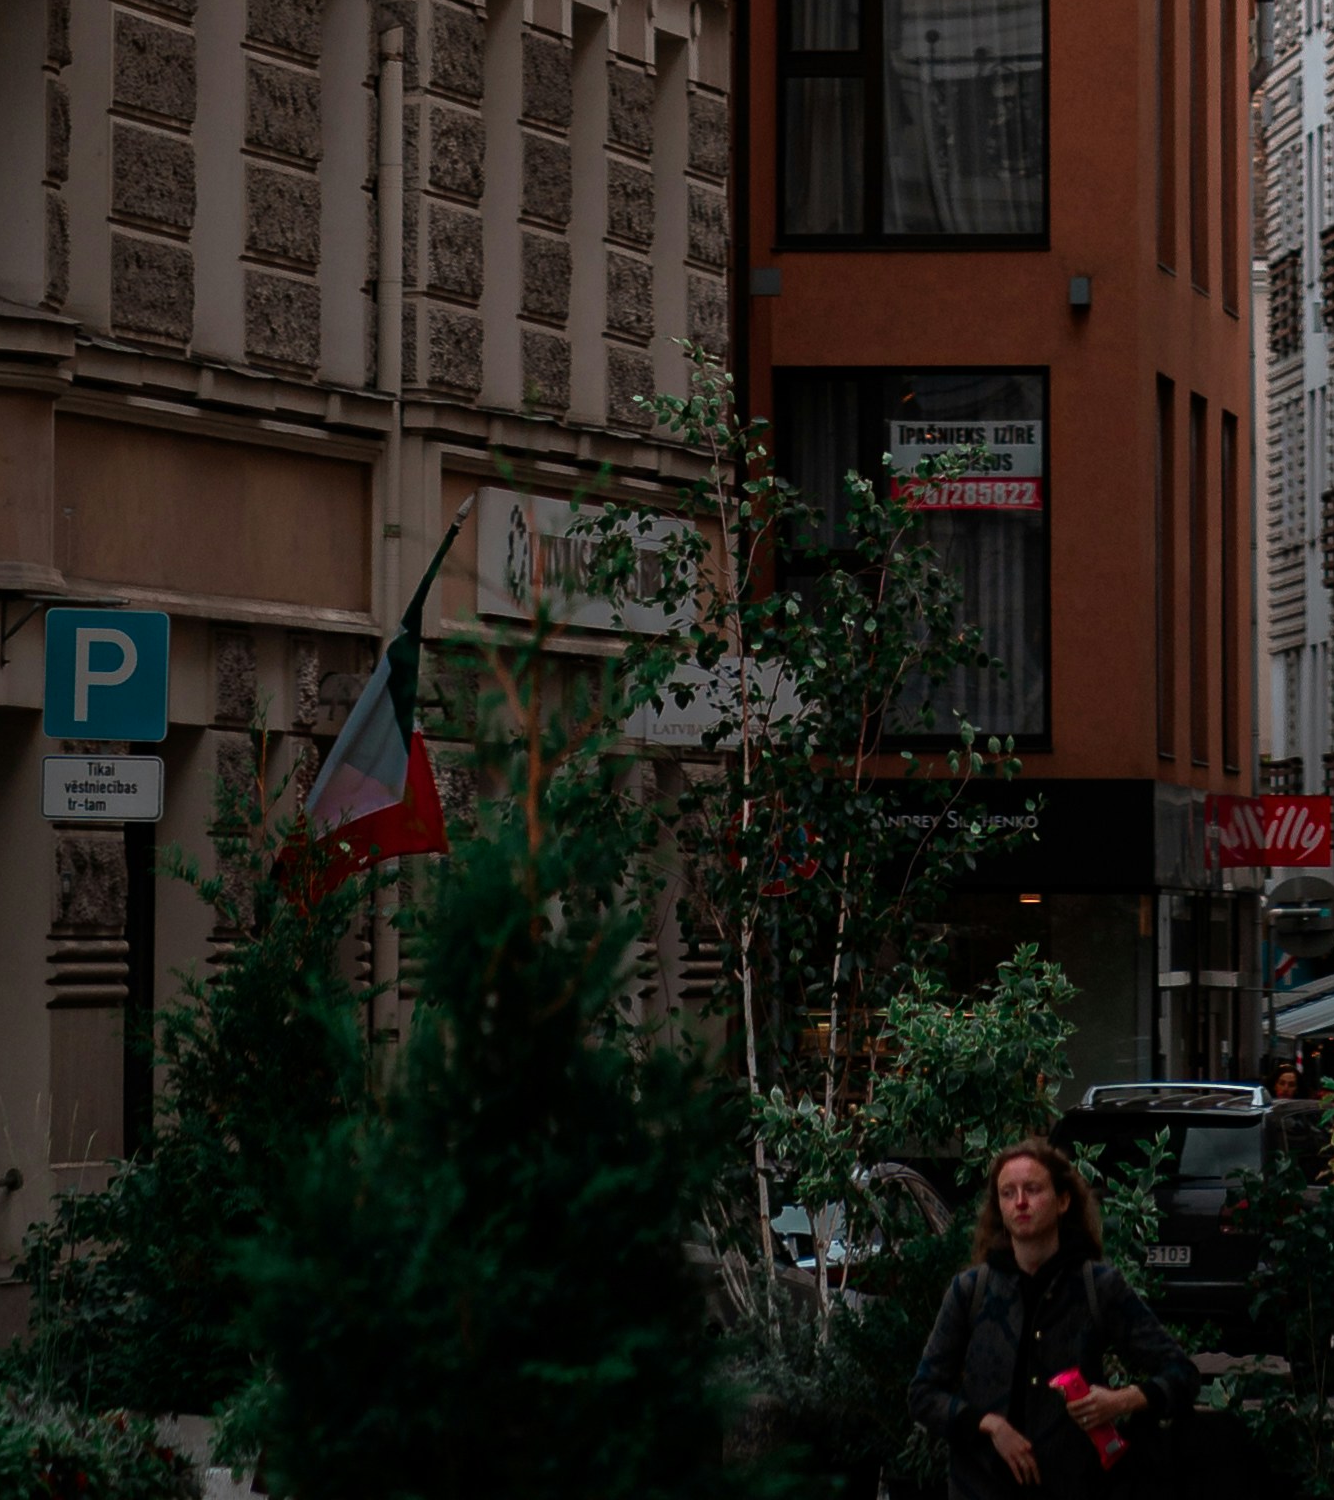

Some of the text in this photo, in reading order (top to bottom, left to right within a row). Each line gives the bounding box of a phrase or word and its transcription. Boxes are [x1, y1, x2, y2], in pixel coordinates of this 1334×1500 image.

[74, 627, 138, 722] P
[87, 762, 115, 776] Tikai
[947, 810, 1039, 828] SILHENKO
[1264, 805, 1325, 860] illy
[1148, 1247, 1188, 1261] 5103
